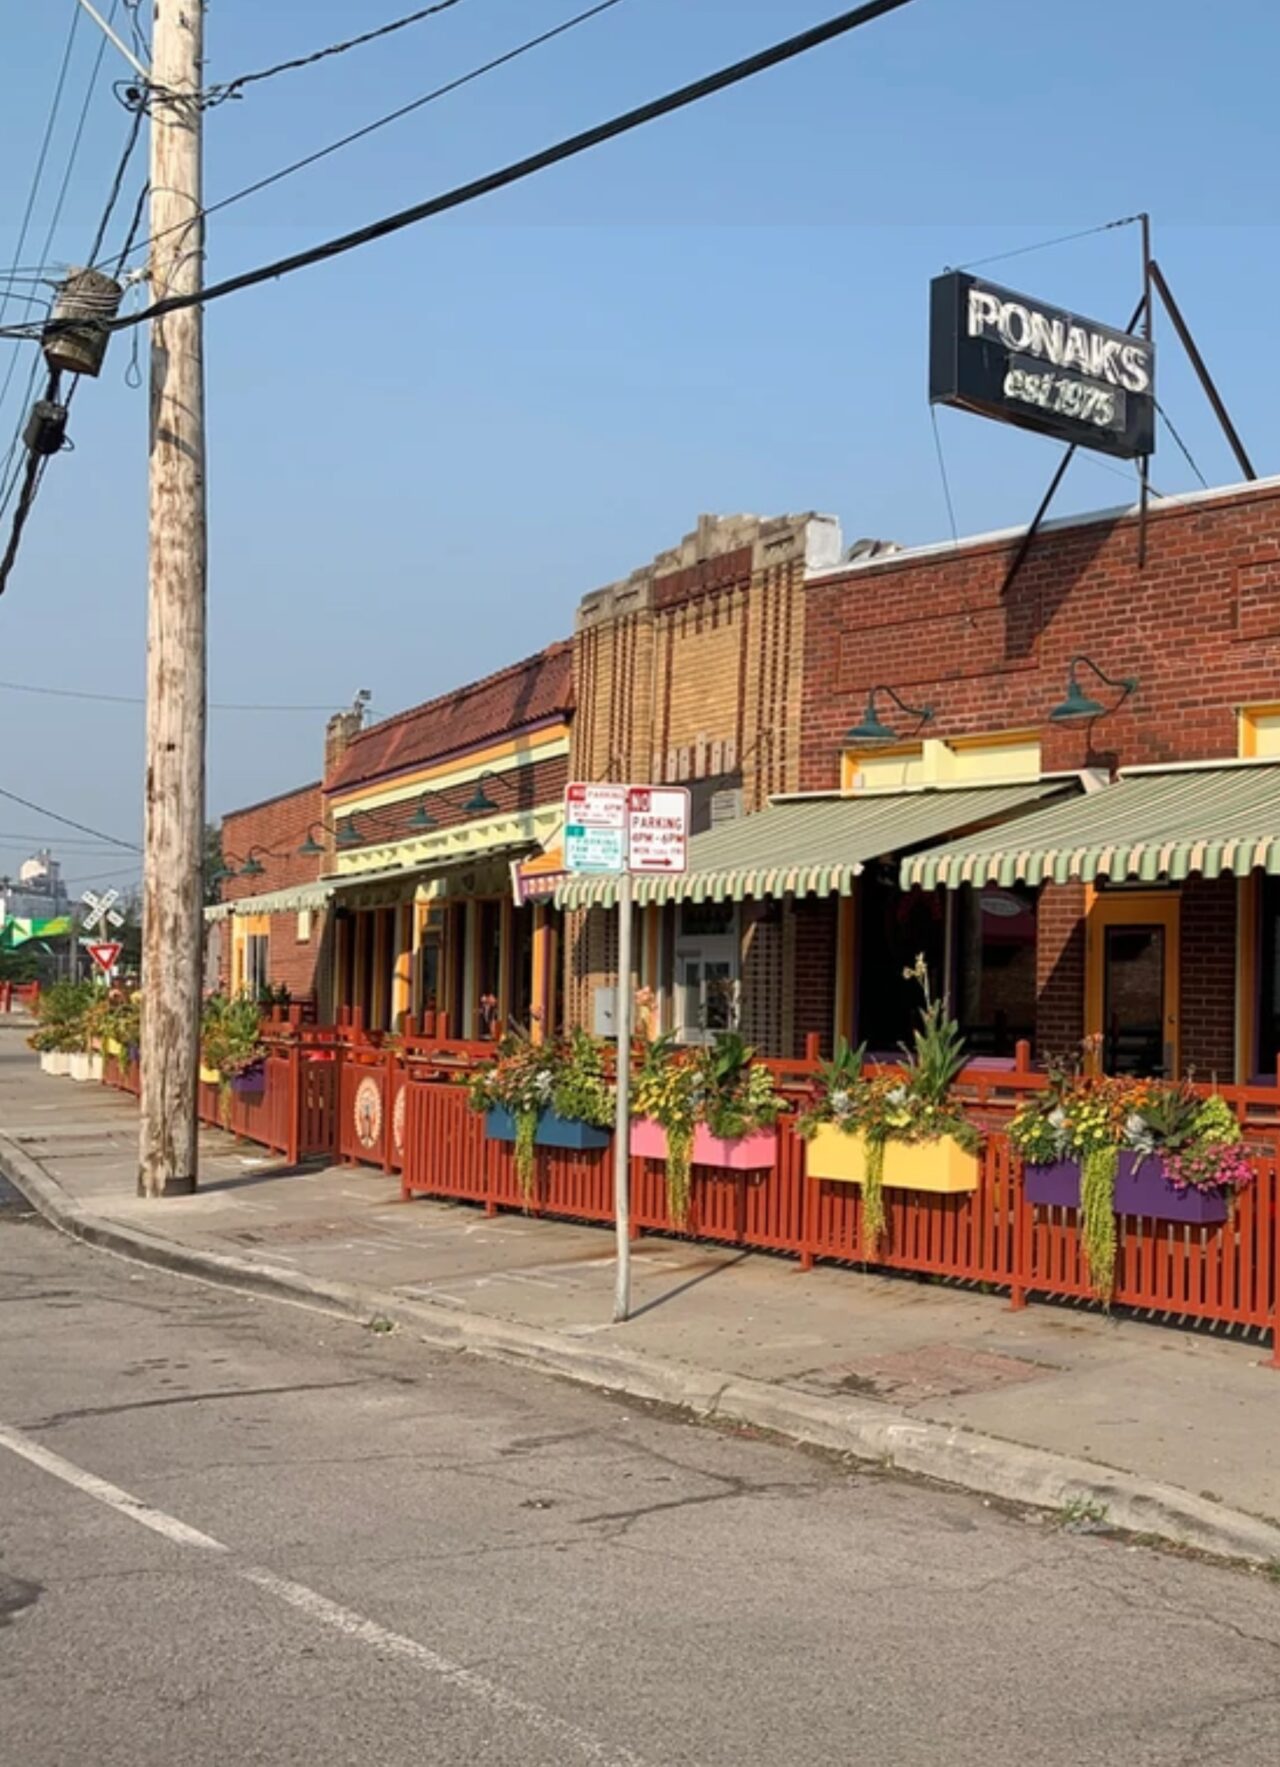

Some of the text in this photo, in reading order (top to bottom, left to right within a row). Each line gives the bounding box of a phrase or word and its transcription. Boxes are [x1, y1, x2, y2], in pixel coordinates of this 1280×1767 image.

[967, 288, 1149, 393] PONAKS
[1053, 378, 1115, 427] 1975
[588, 790, 624, 799] PARKING
[631, 793, 650, 811] NO
[632, 816, 682, 831] PARKING
